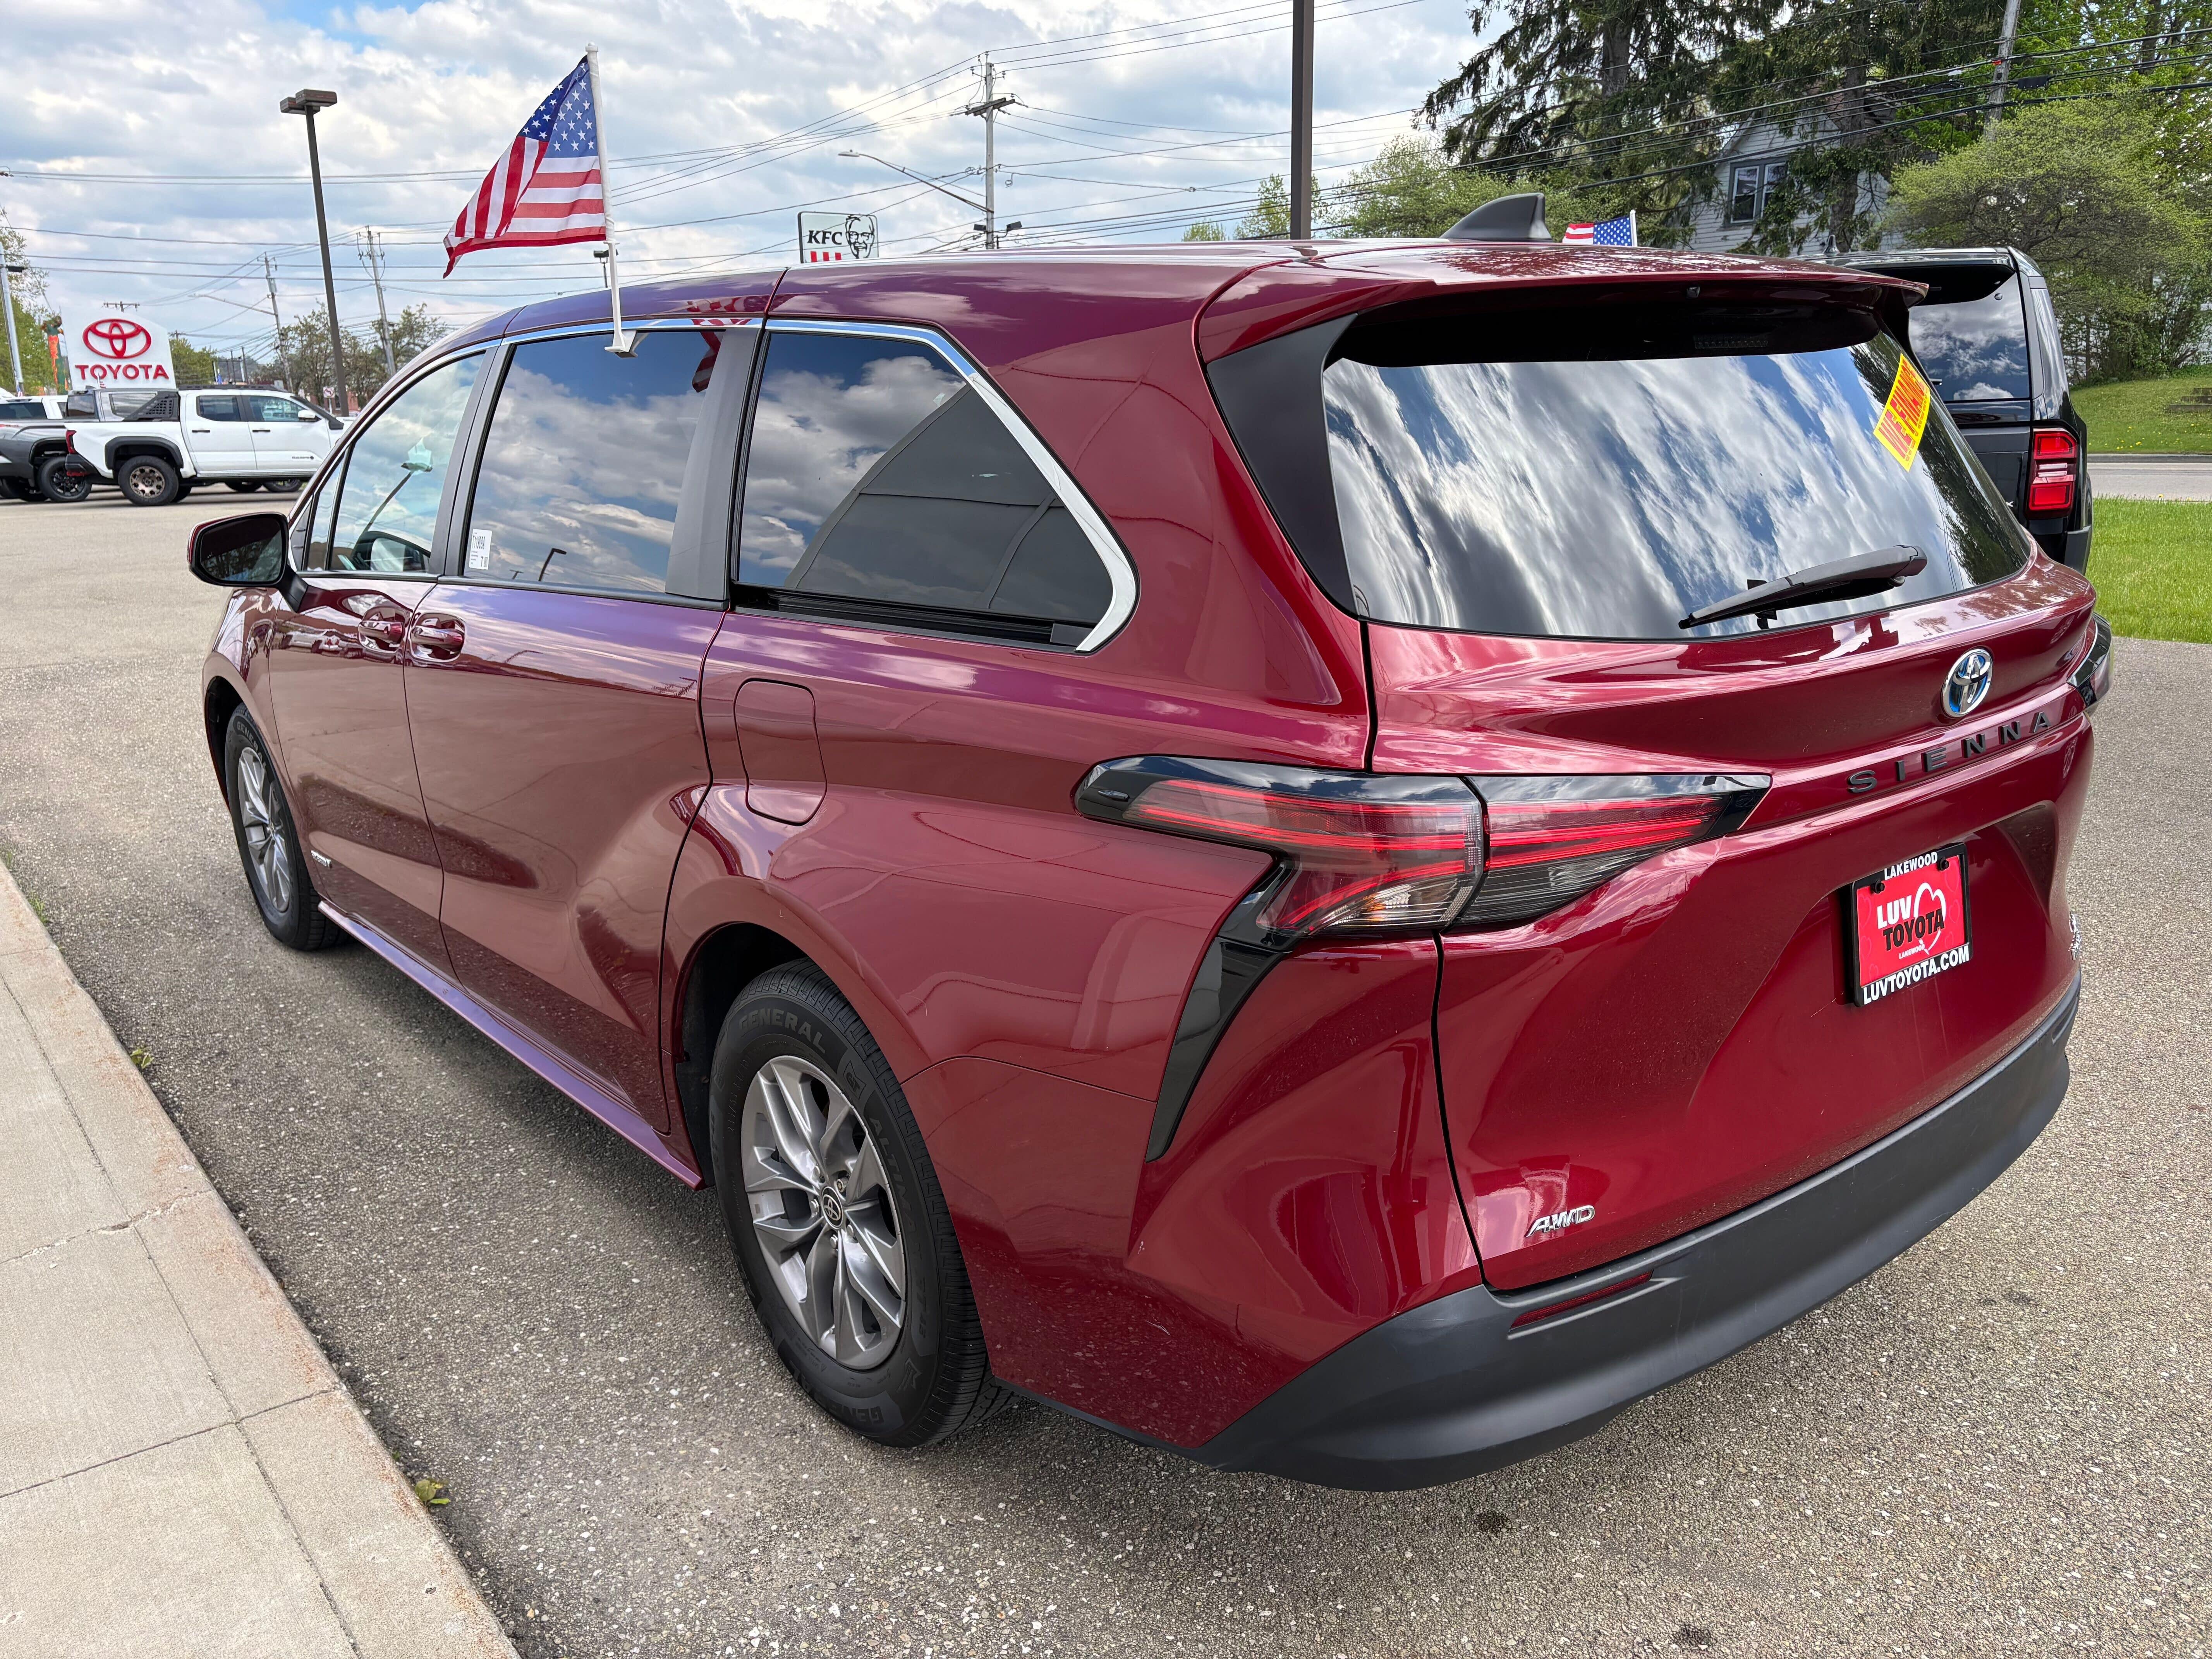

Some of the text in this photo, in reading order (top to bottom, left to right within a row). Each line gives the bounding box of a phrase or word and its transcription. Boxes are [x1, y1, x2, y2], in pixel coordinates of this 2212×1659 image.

[807, 230, 842, 245] KFC
[75, 364, 169, 380] TOYOTA
[1847, 711, 2052, 793] SIENNA
[1884, 851, 1938, 880] LAKEWOOD
[1877, 895, 1912, 929] LUV
[1883, 908, 1945, 951] TOYOTA
[1899, 944, 1925, 959] LAKEWOOD
[1863, 946, 1970, 1005] LUVTOYOTA.COM
[738, 1008, 826, 1054] GENERAL
[1525, 1204, 1595, 1238] AWD
